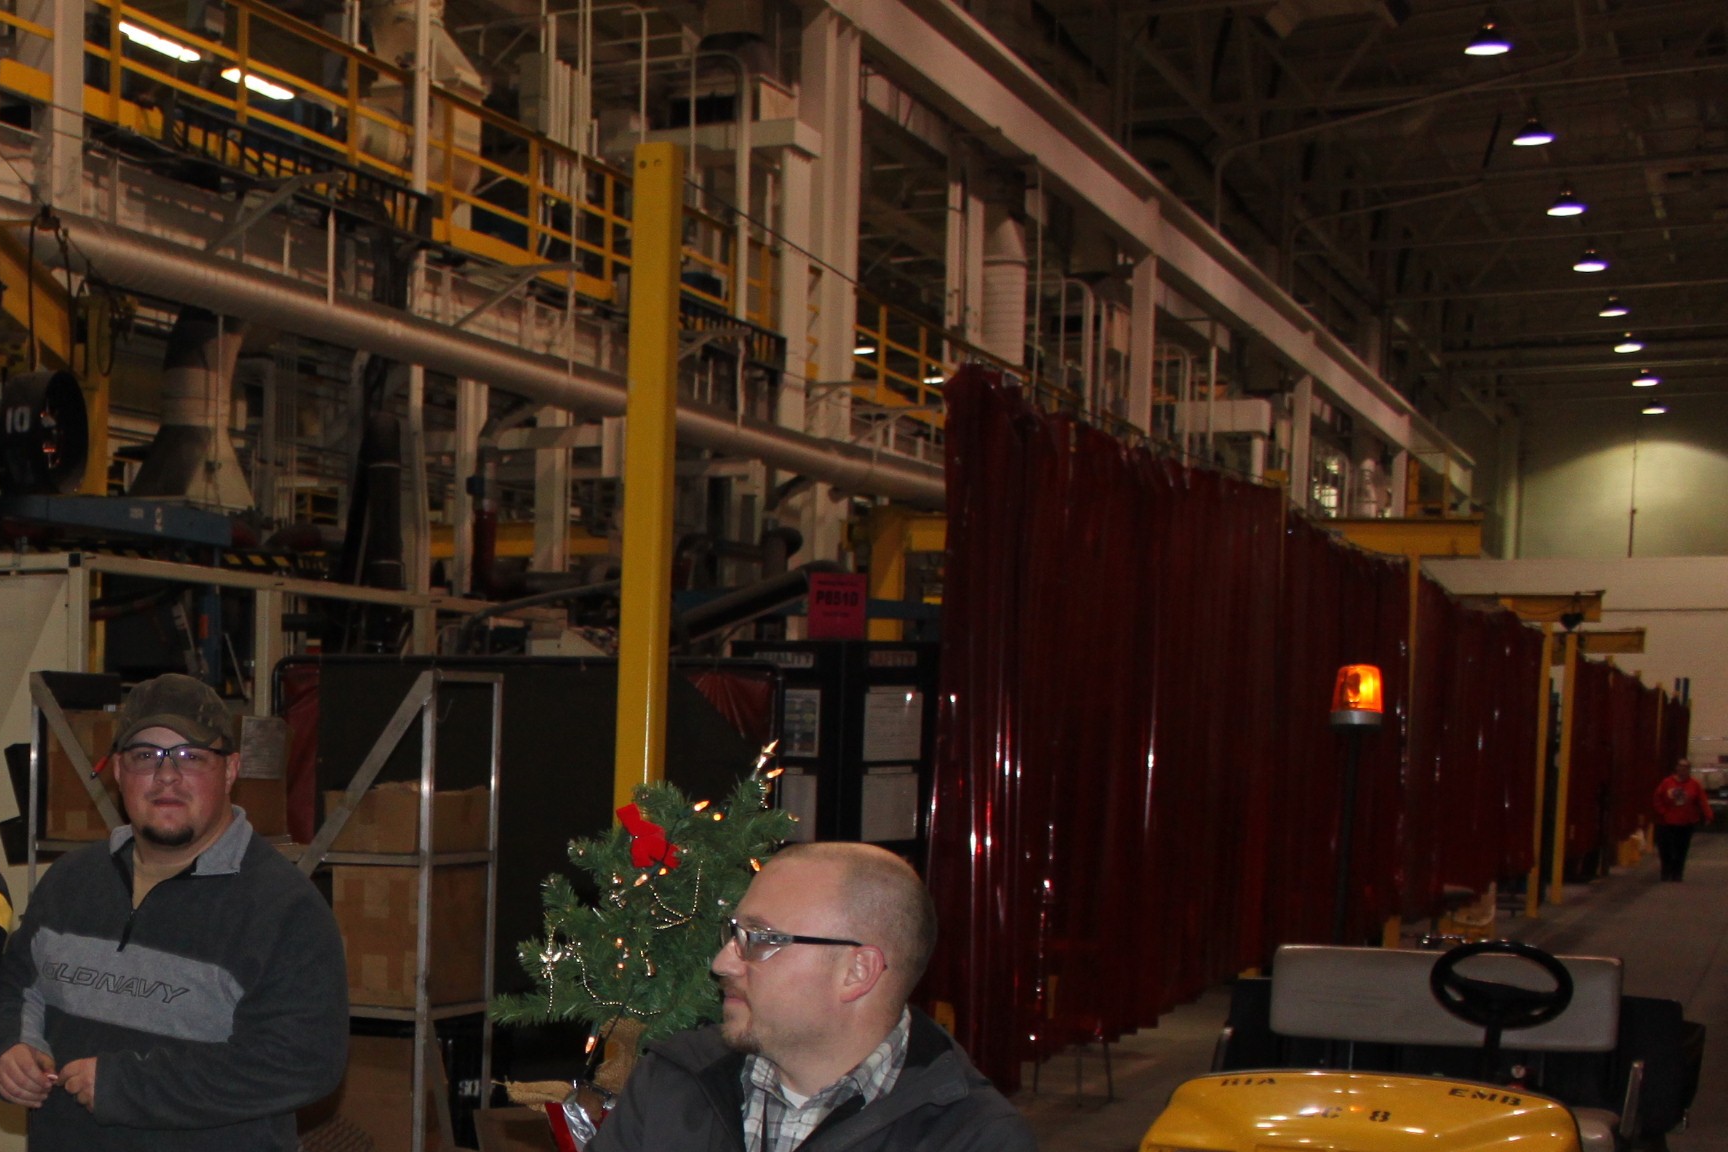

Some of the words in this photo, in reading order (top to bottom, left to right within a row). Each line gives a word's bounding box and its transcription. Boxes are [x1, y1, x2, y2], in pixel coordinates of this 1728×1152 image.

[5, 406, 32, 434] 10
[40, 961, 98, 985] OLD
[95, 972, 190, 1004] NAVY
[1448, 1088, 1521, 1107] EMB
[1369, 1110, 1391, 1123] 8
